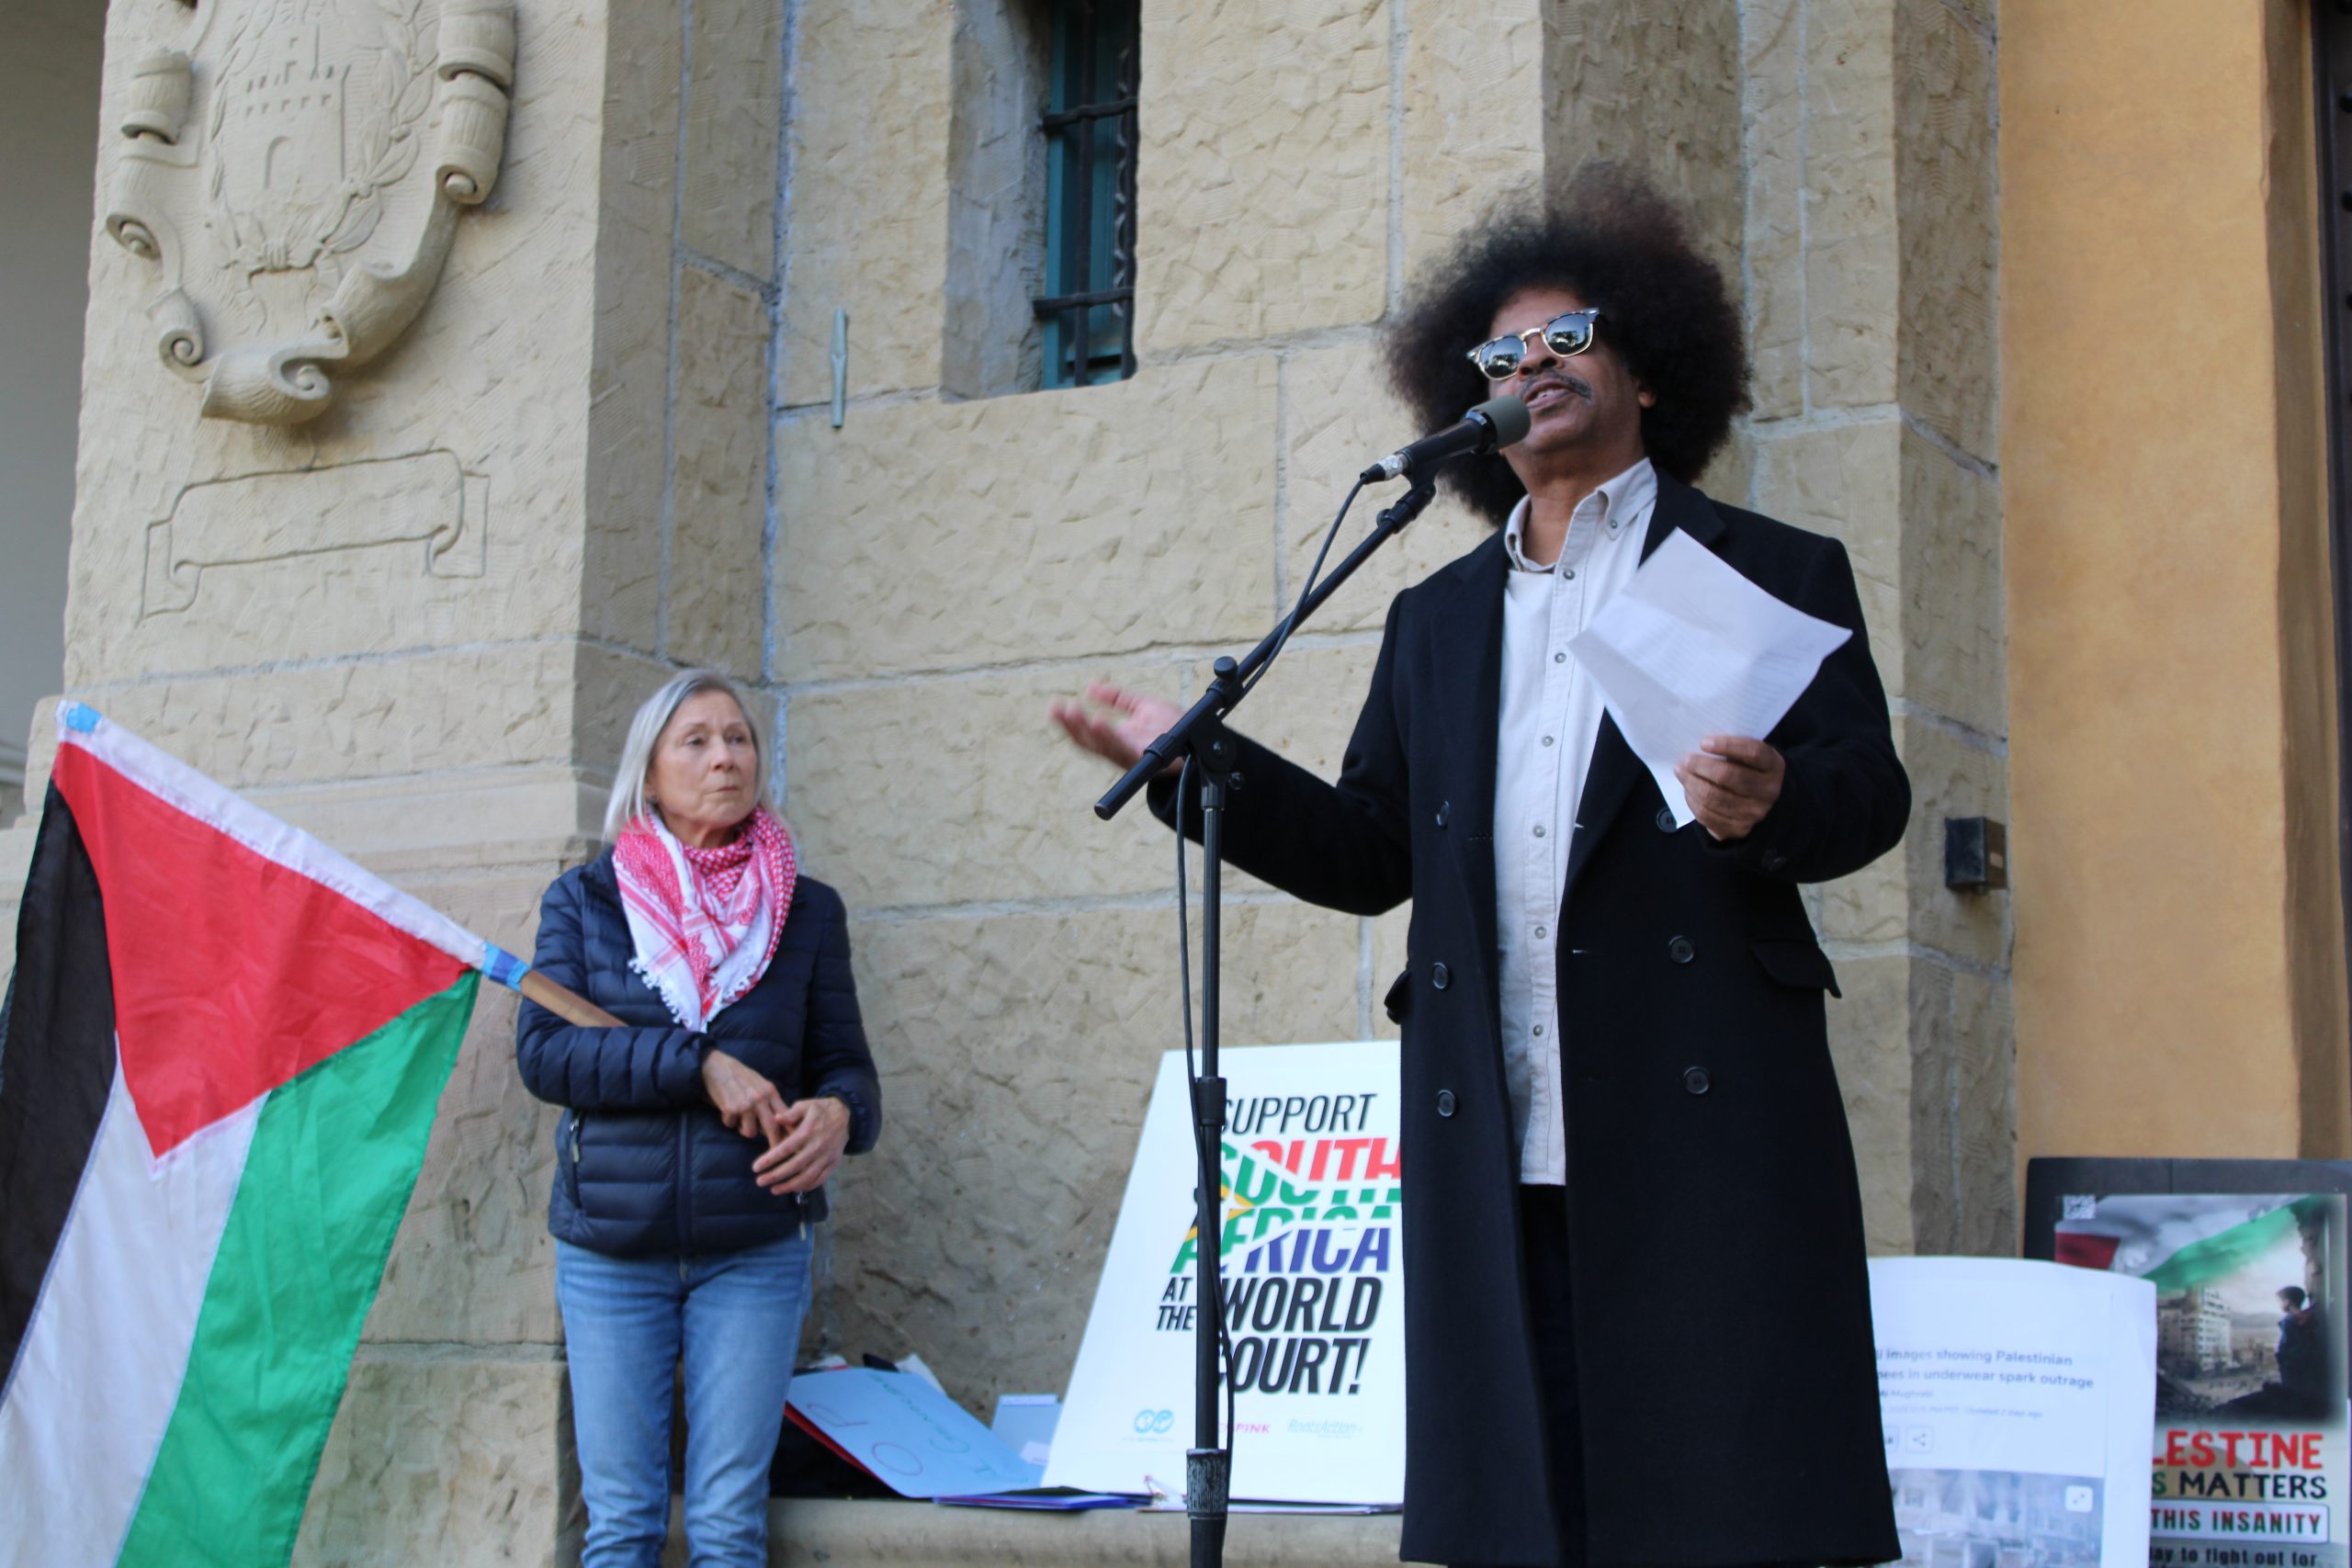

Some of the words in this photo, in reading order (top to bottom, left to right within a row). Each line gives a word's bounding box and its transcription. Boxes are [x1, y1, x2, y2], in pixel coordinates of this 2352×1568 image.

[1161, 1277, 1193, 1303] AT
[1157, 1305, 1197, 1331] THE
[1220, 1277, 1383, 1334] WORLD
[1937, 1348, 1992, 1363] showing
[1996, 1350, 2073, 1366] Palestinian
[1908, 1369, 1920, 1380] in
[1924, 1369, 1995, 1382] underwear
[1999, 1371, 2036, 1384] spark
[2041, 1374, 2094, 1389] outrage
[2179, 1471, 2327, 1499] MATTERS
[2151, 1508, 2200, 1530] THIS
[2211, 1510, 2321, 1535] INSANITY
